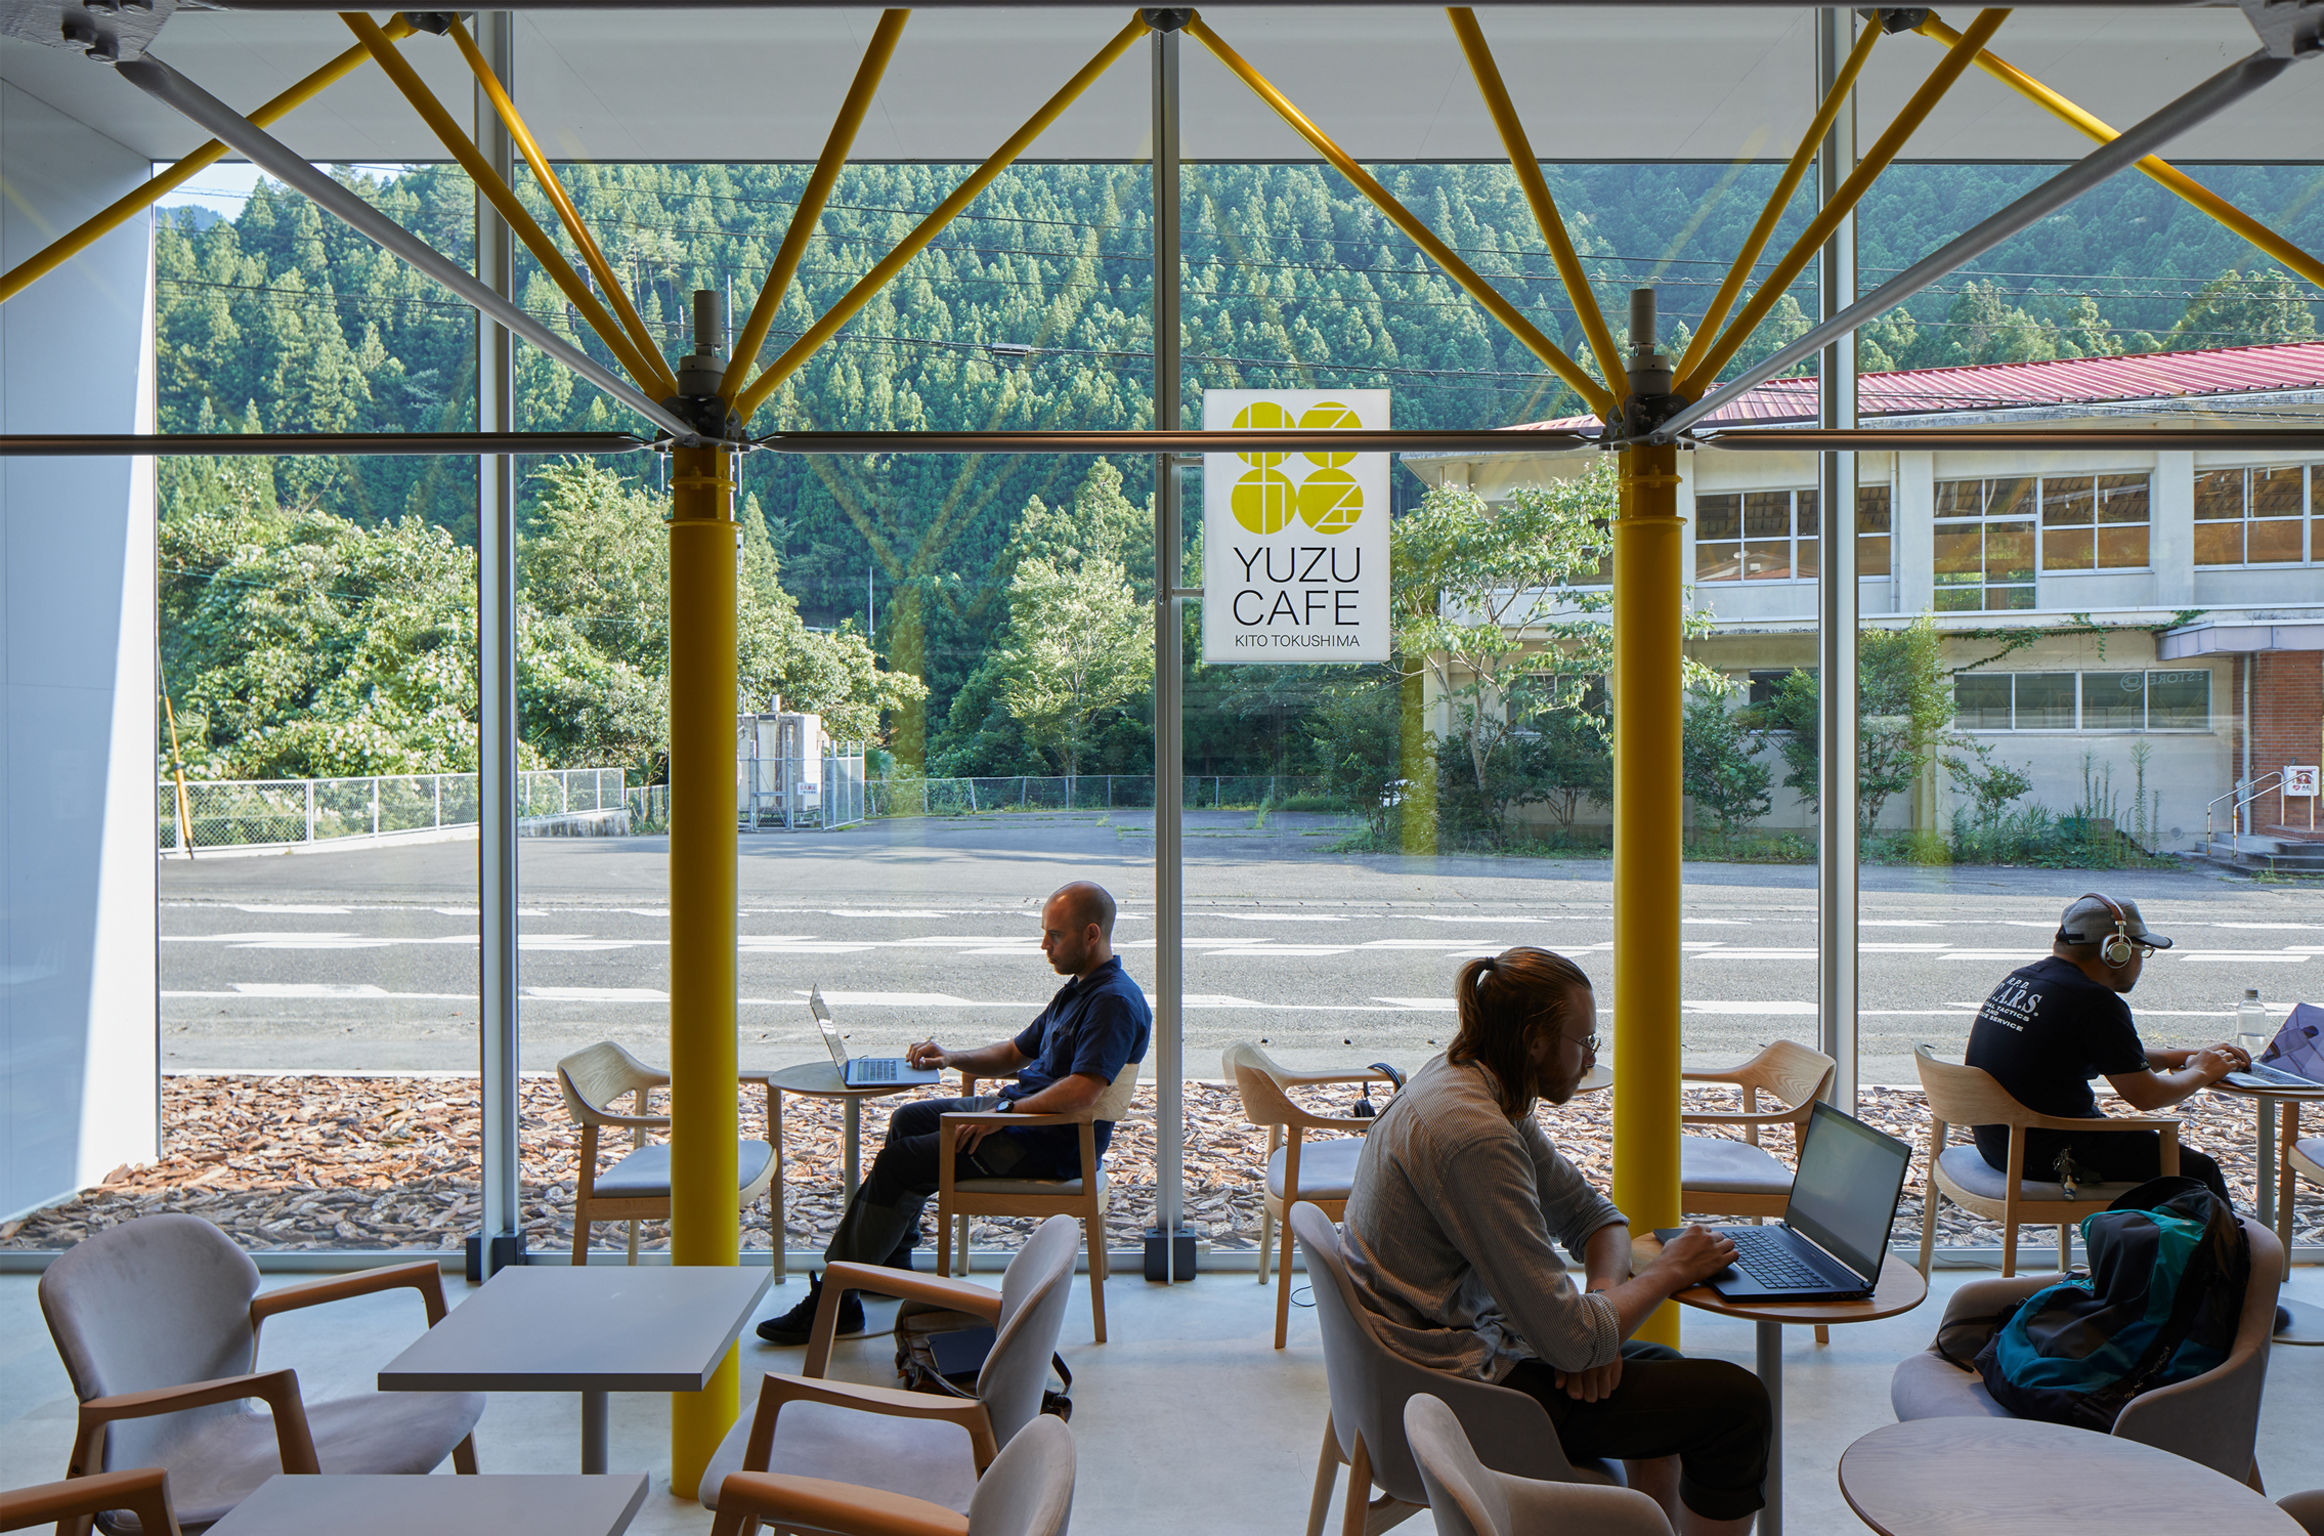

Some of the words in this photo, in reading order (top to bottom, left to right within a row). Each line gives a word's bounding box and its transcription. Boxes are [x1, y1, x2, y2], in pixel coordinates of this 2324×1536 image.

[1233, 547, 1361, 583] YUZU
[1233, 589, 1360, 626] CAFE
[1235, 634, 1268, 647] KITO
[1271, 634, 1361, 647] TOKUSHIMA
[1996, 1003, 2030, 1022] TACTICS
[1989, 1016, 2024, 1032] SERVICE
